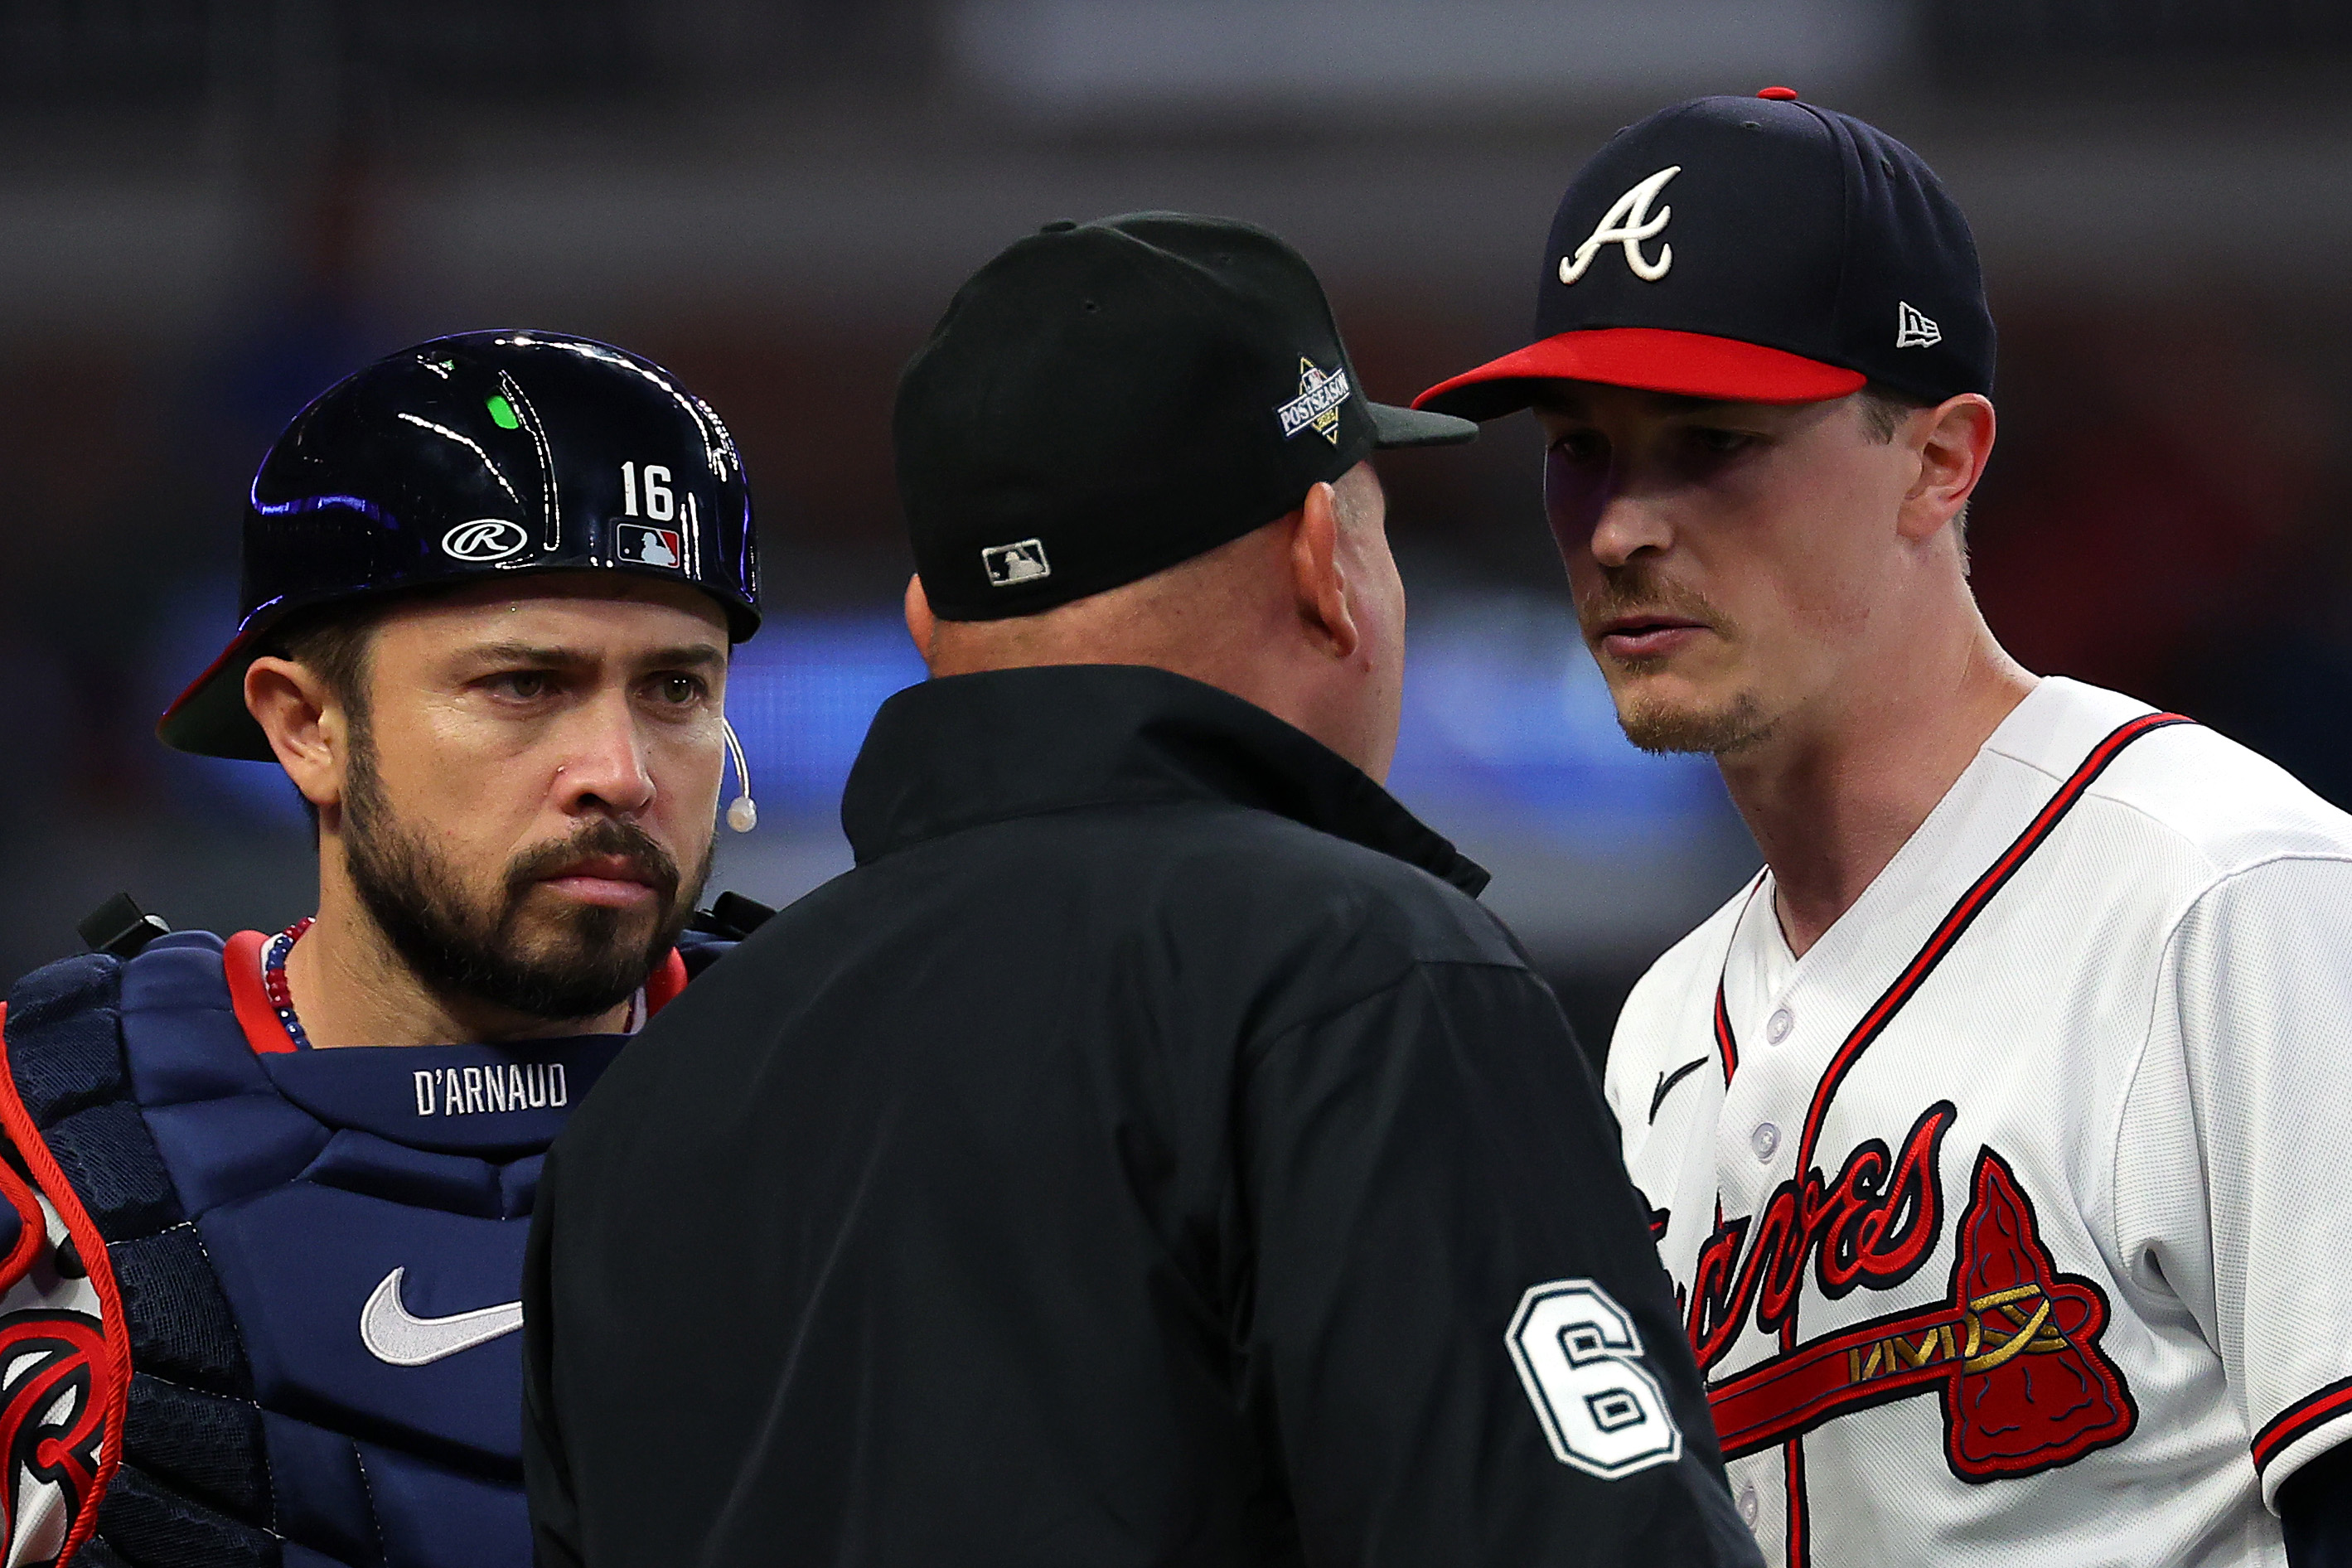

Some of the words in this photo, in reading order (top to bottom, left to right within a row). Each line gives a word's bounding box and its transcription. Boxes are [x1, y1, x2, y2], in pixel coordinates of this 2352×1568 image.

[1559, 166, 1682, 284] A
[1280, 372, 1349, 432] POSTSEASON
[622, 461, 674, 520] 16
[414, 1064, 568, 1116] D'ARNAUD
[1503, 1279, 1683, 1479] 6
